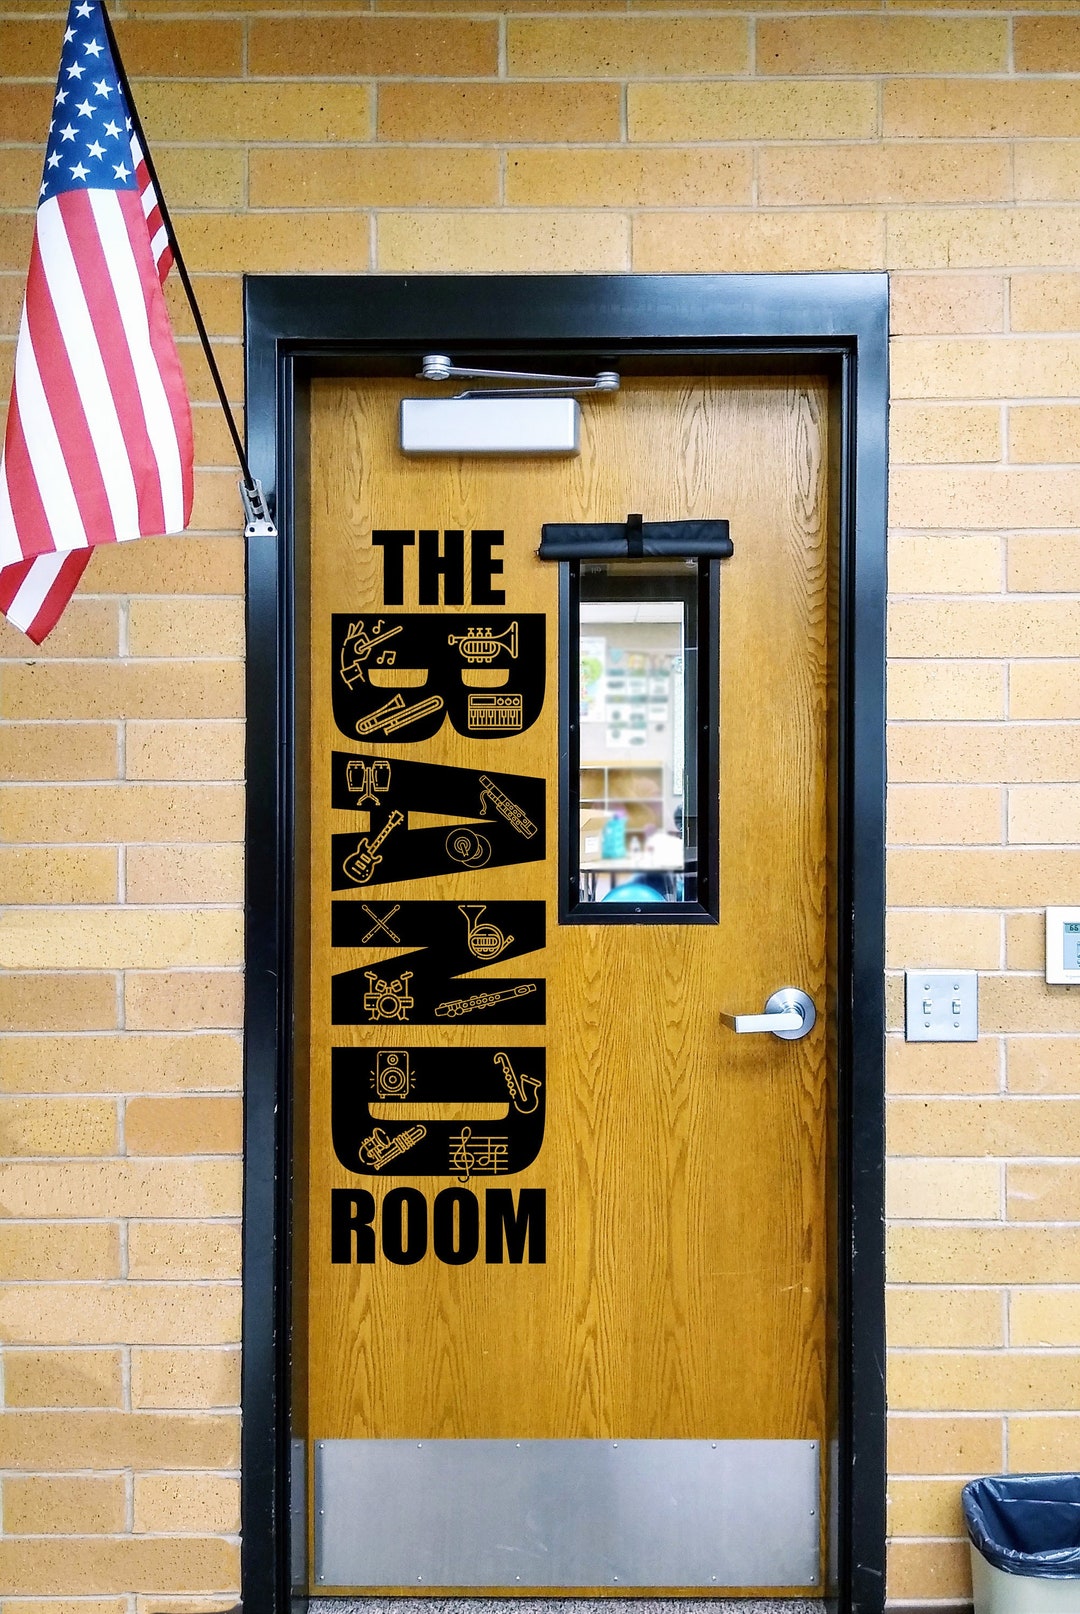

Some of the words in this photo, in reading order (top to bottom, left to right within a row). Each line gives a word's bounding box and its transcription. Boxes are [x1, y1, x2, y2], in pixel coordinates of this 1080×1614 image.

[372, 530, 505, 605] THE
[331, 613, 546, 1177] BAND
[331, 1187, 546, 1265] ROOM
